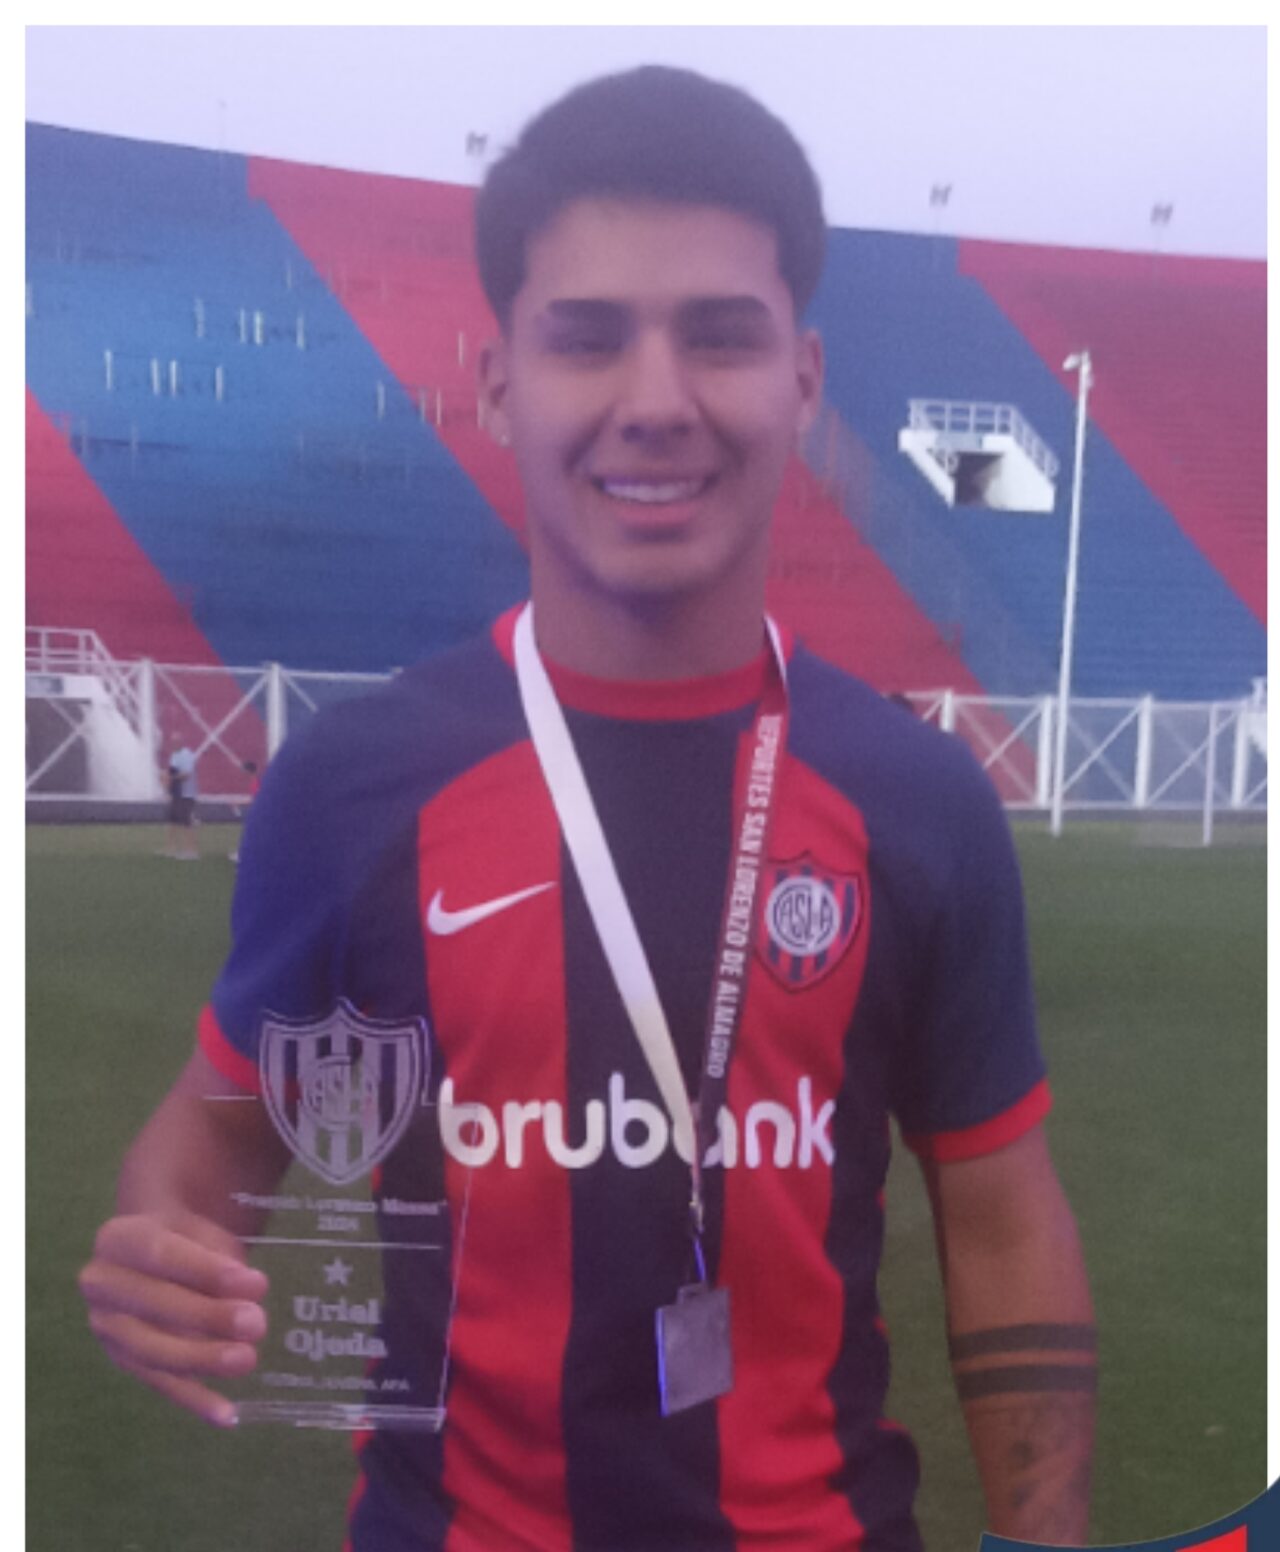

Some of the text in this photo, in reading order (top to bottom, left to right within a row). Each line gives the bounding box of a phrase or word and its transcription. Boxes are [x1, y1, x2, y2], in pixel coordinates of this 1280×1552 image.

[740, 812, 766, 856] SAN
[726, 857, 759, 947] LORENZO
[720, 948, 745, 977] DE
[706, 980, 740, 1079] ALMAGRO
[284, 1328, 387, 1361] Ojeda
